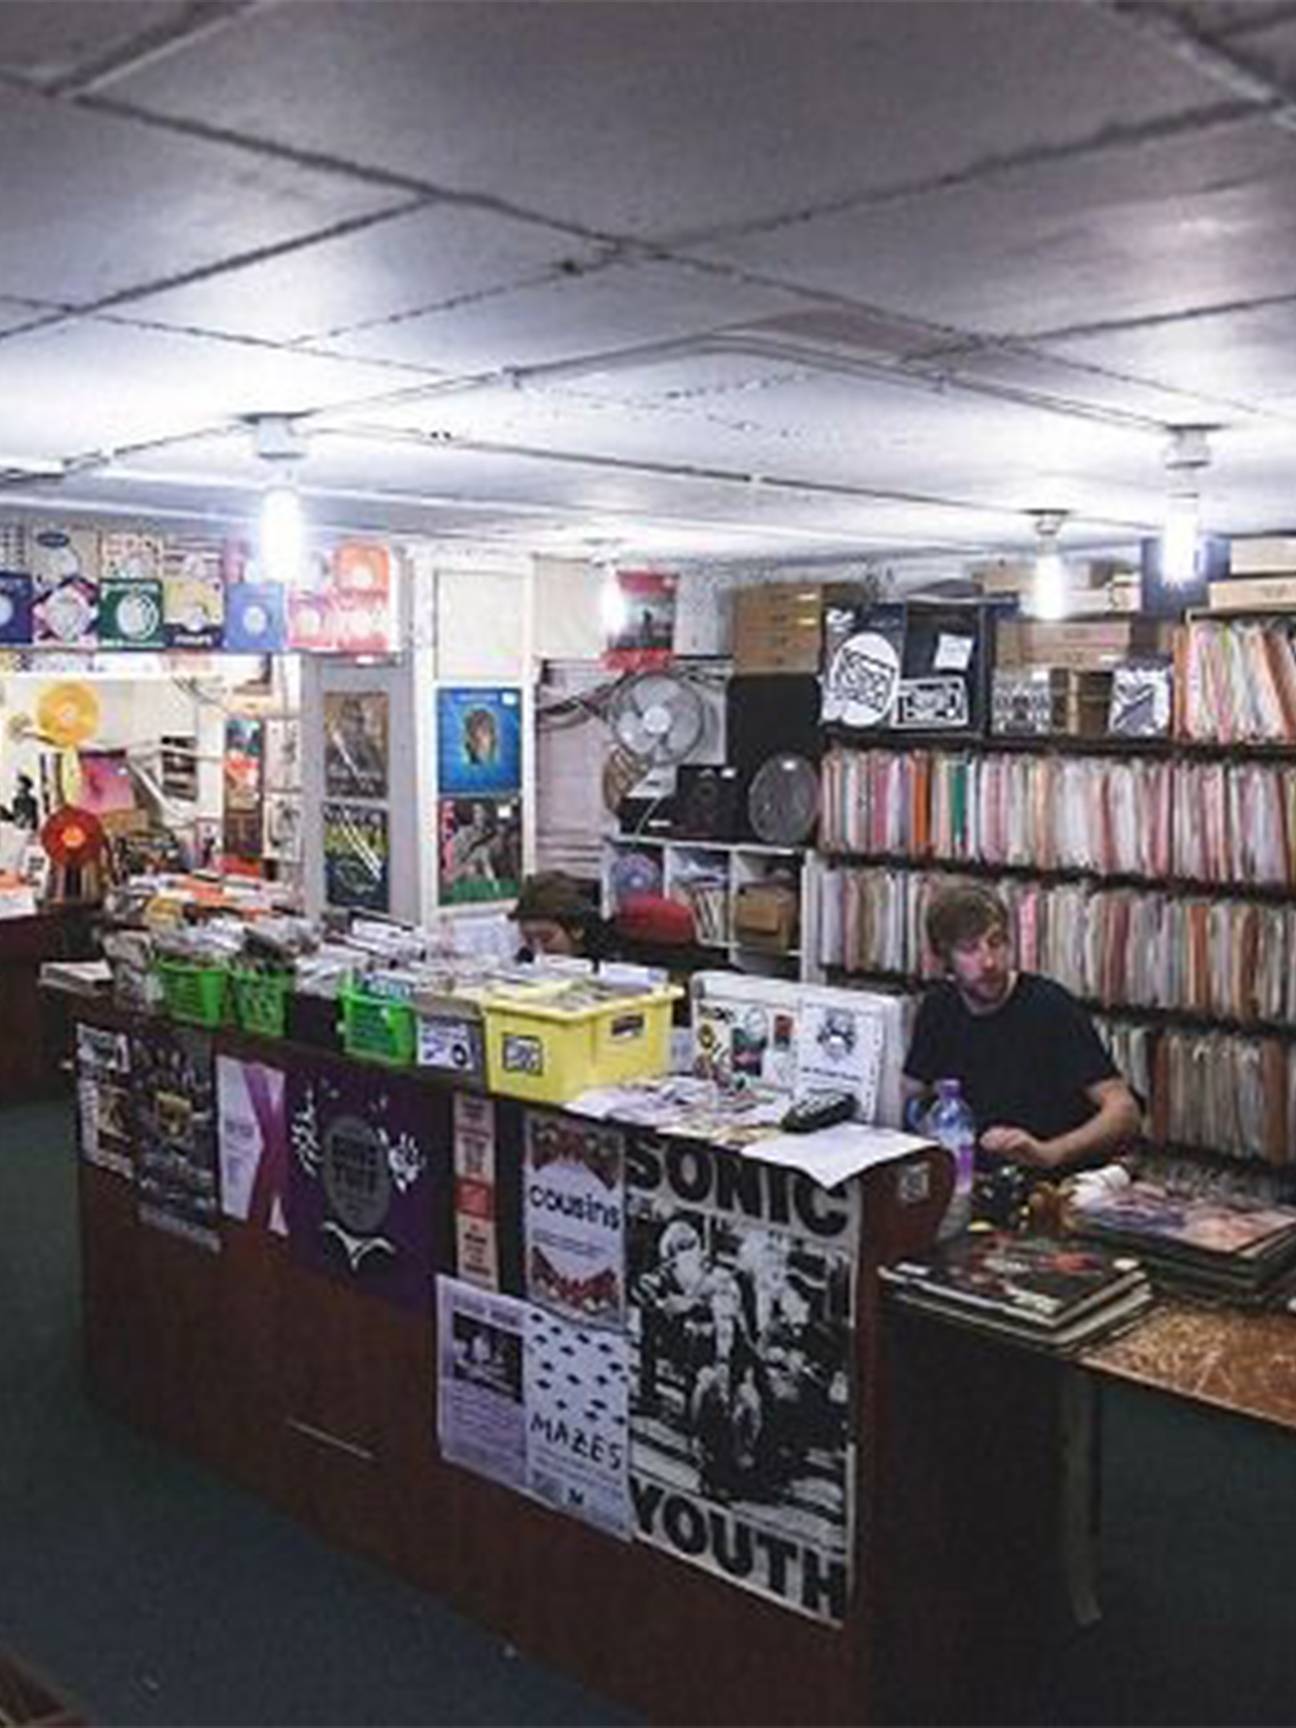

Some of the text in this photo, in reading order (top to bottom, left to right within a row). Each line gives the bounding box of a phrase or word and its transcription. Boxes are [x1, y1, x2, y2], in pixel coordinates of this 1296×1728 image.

[528, 1184, 620, 1231] cousins
[626, 1137, 849, 1238] SONIC
[529, 1412, 624, 1471] MAZES
[628, 1474, 847, 1618] YOUTH
